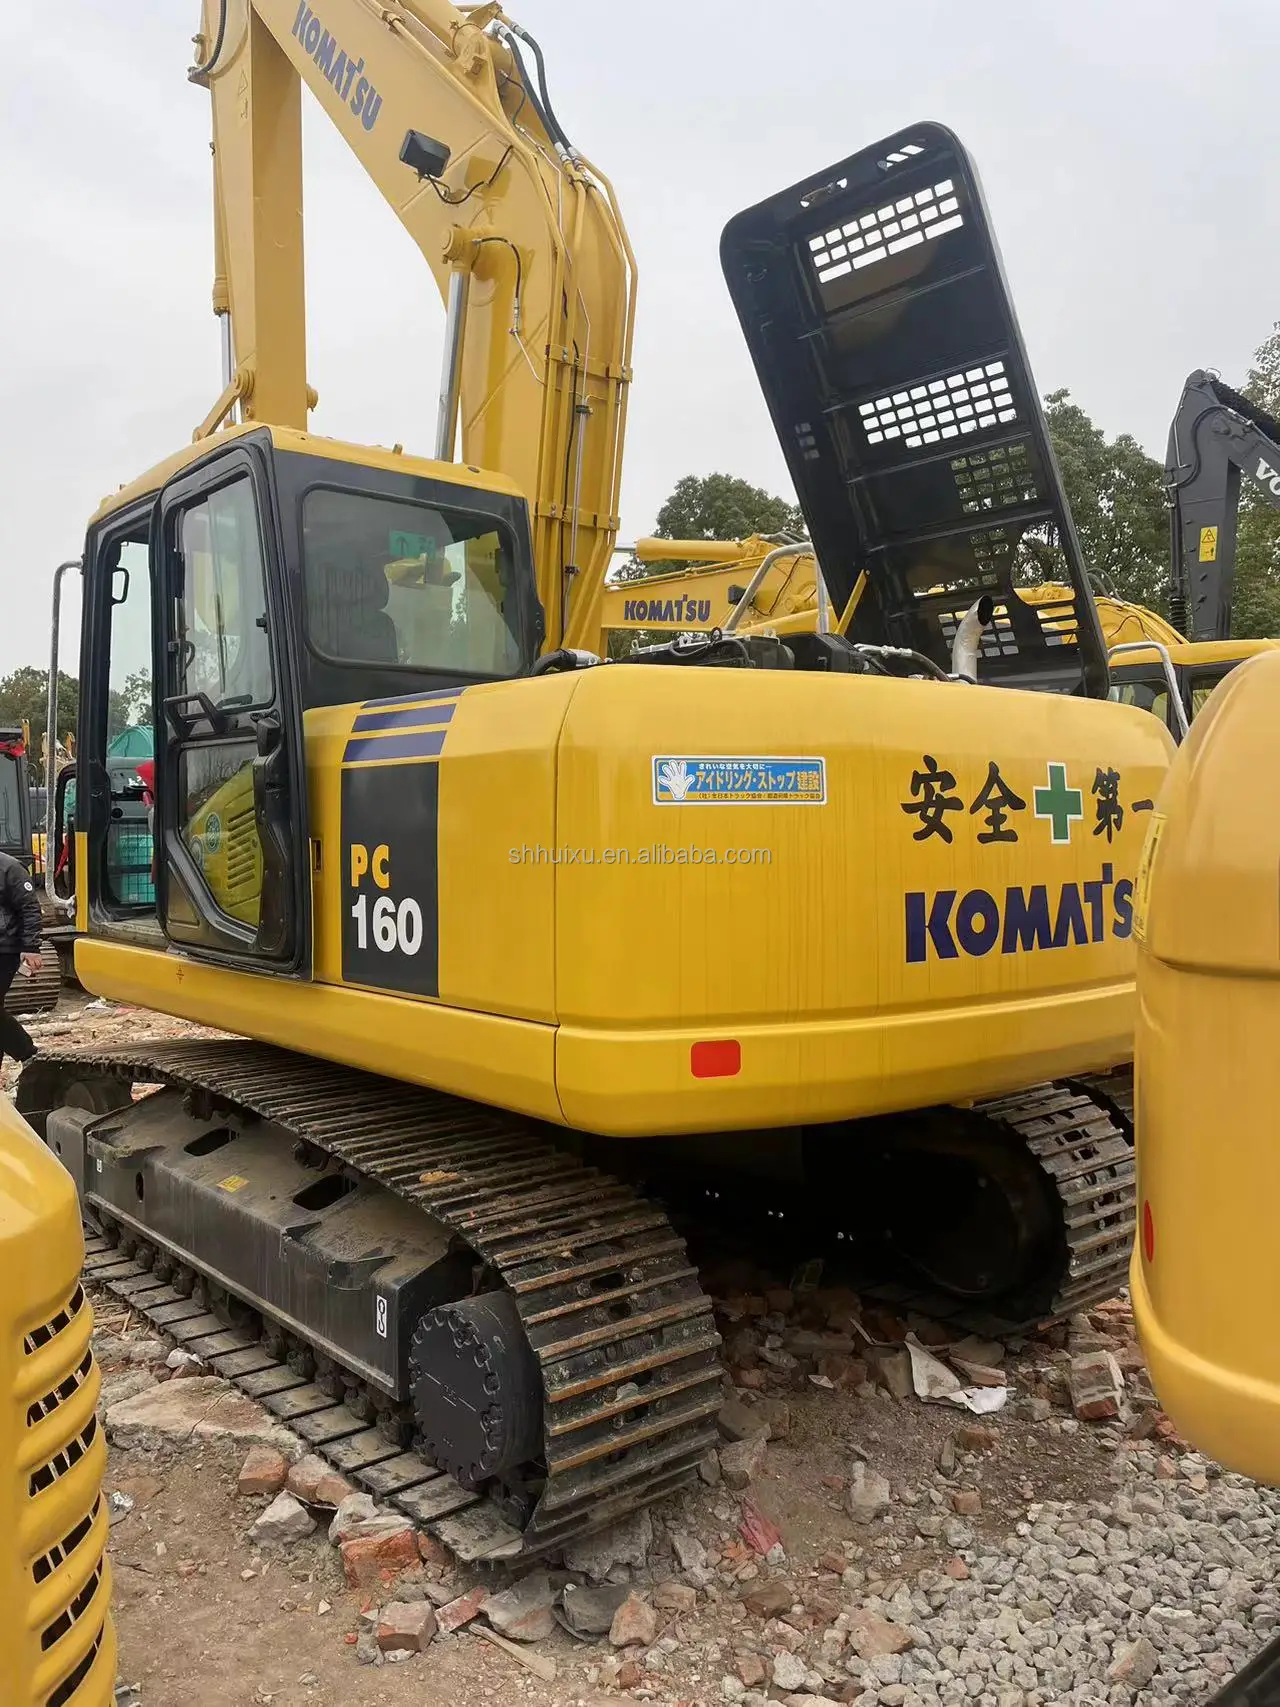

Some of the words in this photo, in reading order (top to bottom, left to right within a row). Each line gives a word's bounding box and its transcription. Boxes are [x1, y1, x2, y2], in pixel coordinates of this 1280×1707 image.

[291, 0, 383, 131] KOMATSU
[624, 594, 711, 622] KOMATSU
[900, 755, 1027, 844] 安全
[350, 843, 390, 890] PC
[351, 894, 423, 956] 160
[905, 863, 1138, 963] KOMATS
